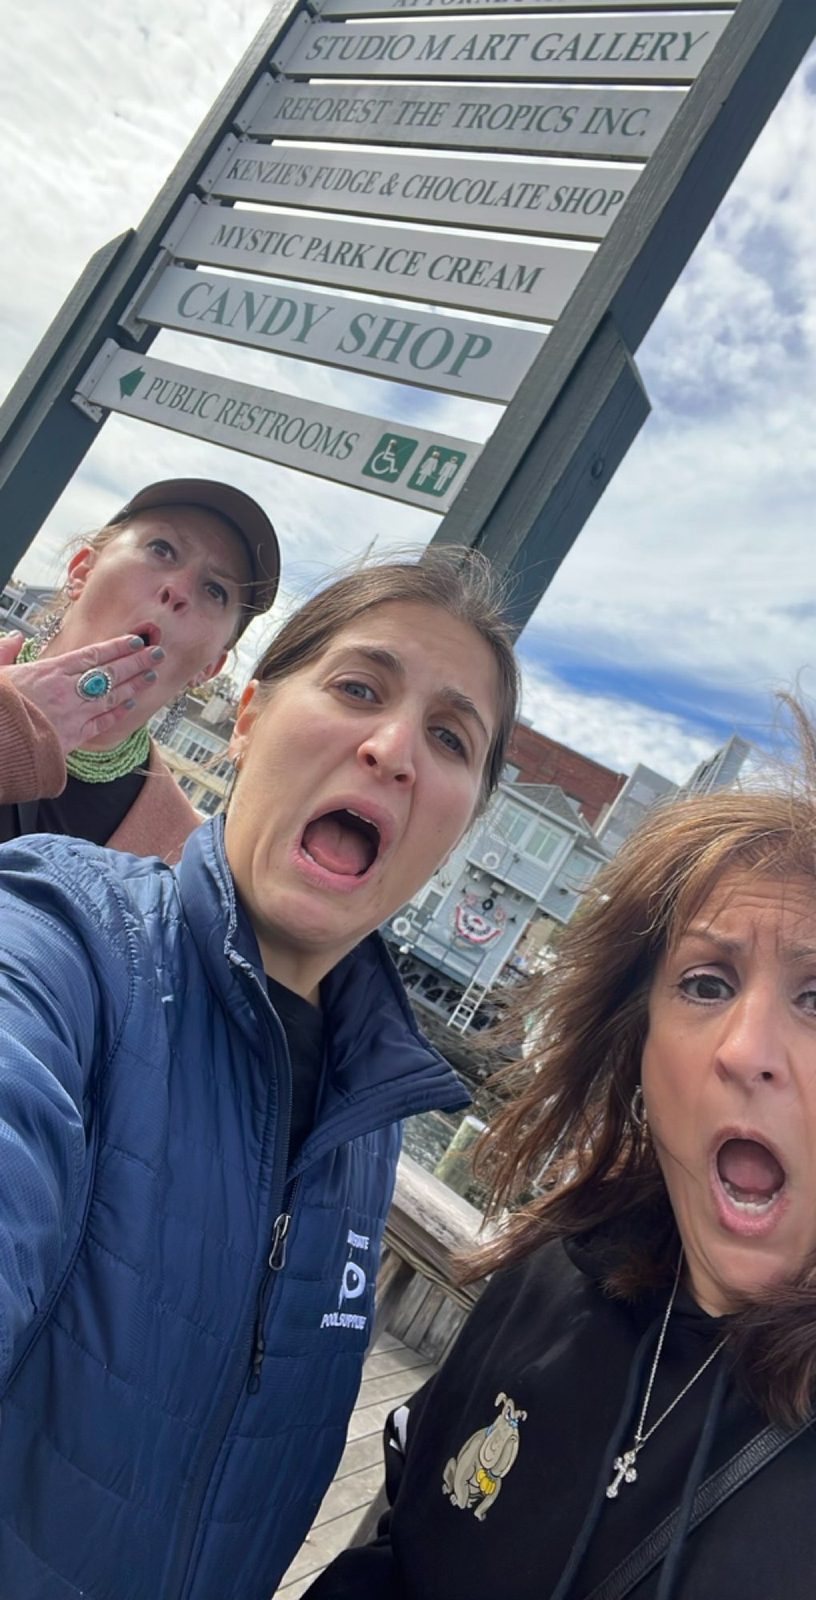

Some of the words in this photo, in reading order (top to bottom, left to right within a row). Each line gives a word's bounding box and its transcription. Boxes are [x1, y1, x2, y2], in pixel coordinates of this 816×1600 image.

[306, 35, 415, 61] STUDIO
[415, 34, 455, 61] M
[451, 33, 529, 61] ART
[530, 31, 709, 62] GALLERY
[274, 97, 394, 125] REFOREST
[393, 101, 450, 127] THE
[452, 102, 580, 133] TROPICS
[580, 107, 651, 137] INC.
[226, 158, 314, 187] KENZIE'S
[312, 166, 382, 195] FUDGE
[378, 172, 400, 196] &
[401, 174, 549, 211] CHOCOLATE
[546, 185, 625, 217] SHOP
[211, 224, 303, 258] MYSTIC
[301, 236, 376, 269] PARK
[371, 246, 427, 277] ICE
[427, 254, 545, 295] CREAM
[177, 281, 336, 344] CANDY
[336, 312, 493, 378] SHOP
[142, 376, 222, 419] PUBLIC
[214, 398, 360, 461] RESTROOMS
